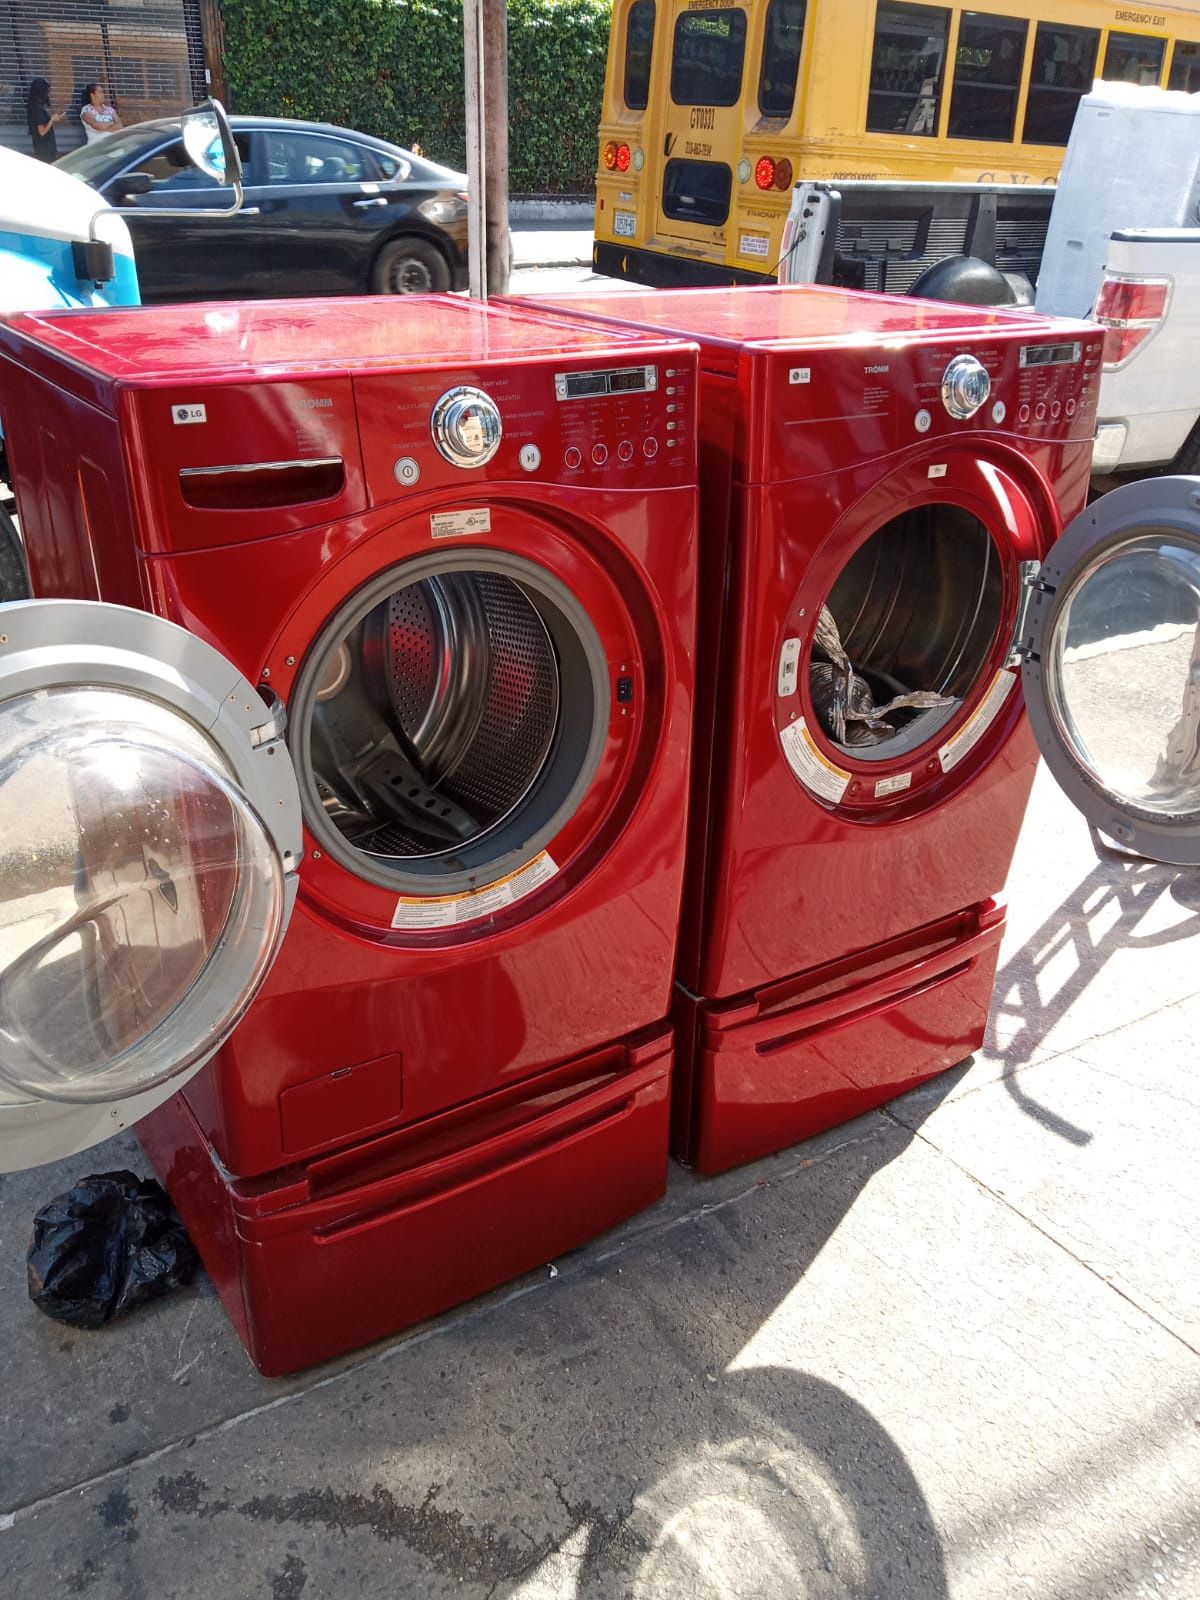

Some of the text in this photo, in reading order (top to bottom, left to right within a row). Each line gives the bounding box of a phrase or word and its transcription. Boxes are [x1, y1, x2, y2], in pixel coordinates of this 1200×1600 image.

[1115, 10, 1166, 26] EMERGENCY EXIT
[864, 365, 889, 374] TROMM
[190, 409, 203, 419] LG
